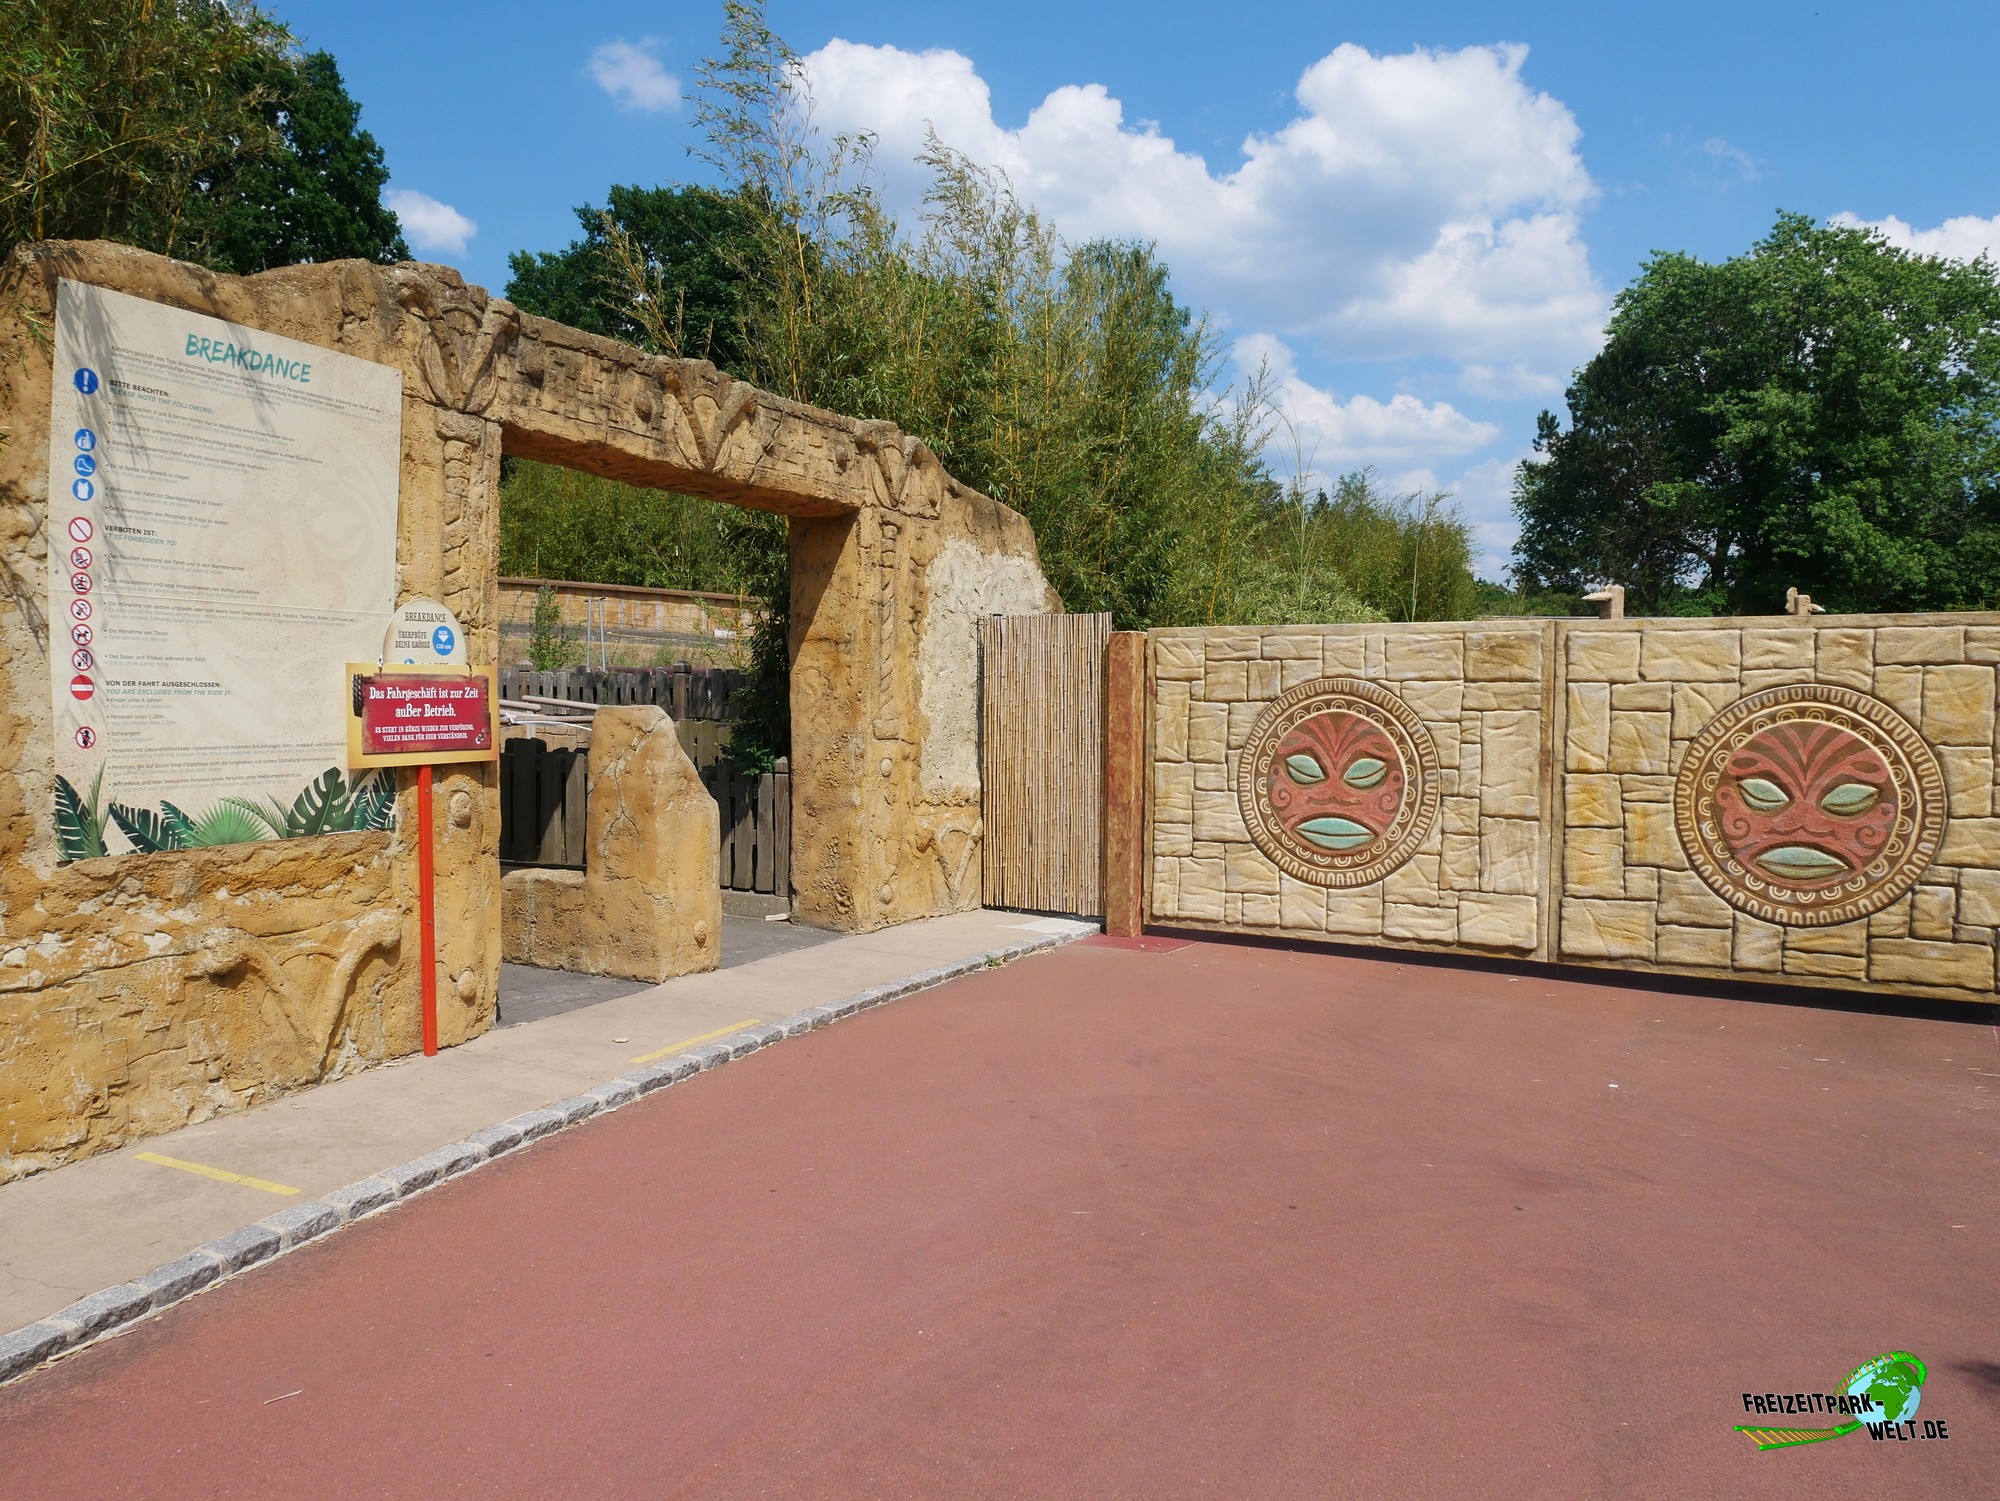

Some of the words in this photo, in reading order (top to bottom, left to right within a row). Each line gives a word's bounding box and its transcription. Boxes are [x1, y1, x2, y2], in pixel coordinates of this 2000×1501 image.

[185, 333, 312, 383] BREAKDANCE
[110, 379, 130, 389] BITTE
[132, 384, 170, 397] BEACHTEN:
[110, 387, 135, 398] PLEASE
[138, 393, 154, 402] NOTE
[158, 397, 170, 405] THE
[173, 400, 213, 414] FOLLOWING:
[104, 524, 141, 534] VERBOTEN
[124, 534, 164, 545] FORBIDDEN
[404, 612, 447, 622] BREAKDANCE
[395, 640, 410, 648] DEINE
[369, 687, 384, 699] Das
[386, 687, 437, 701] Fahrgeschäft
[439, 688, 448, 699] ist
[450, 689, 462, 698] zur
[465, 687, 479, 698] Zeit
[395, 704, 422, 717] außer
[424, 703, 456, 717] Betrieb.
